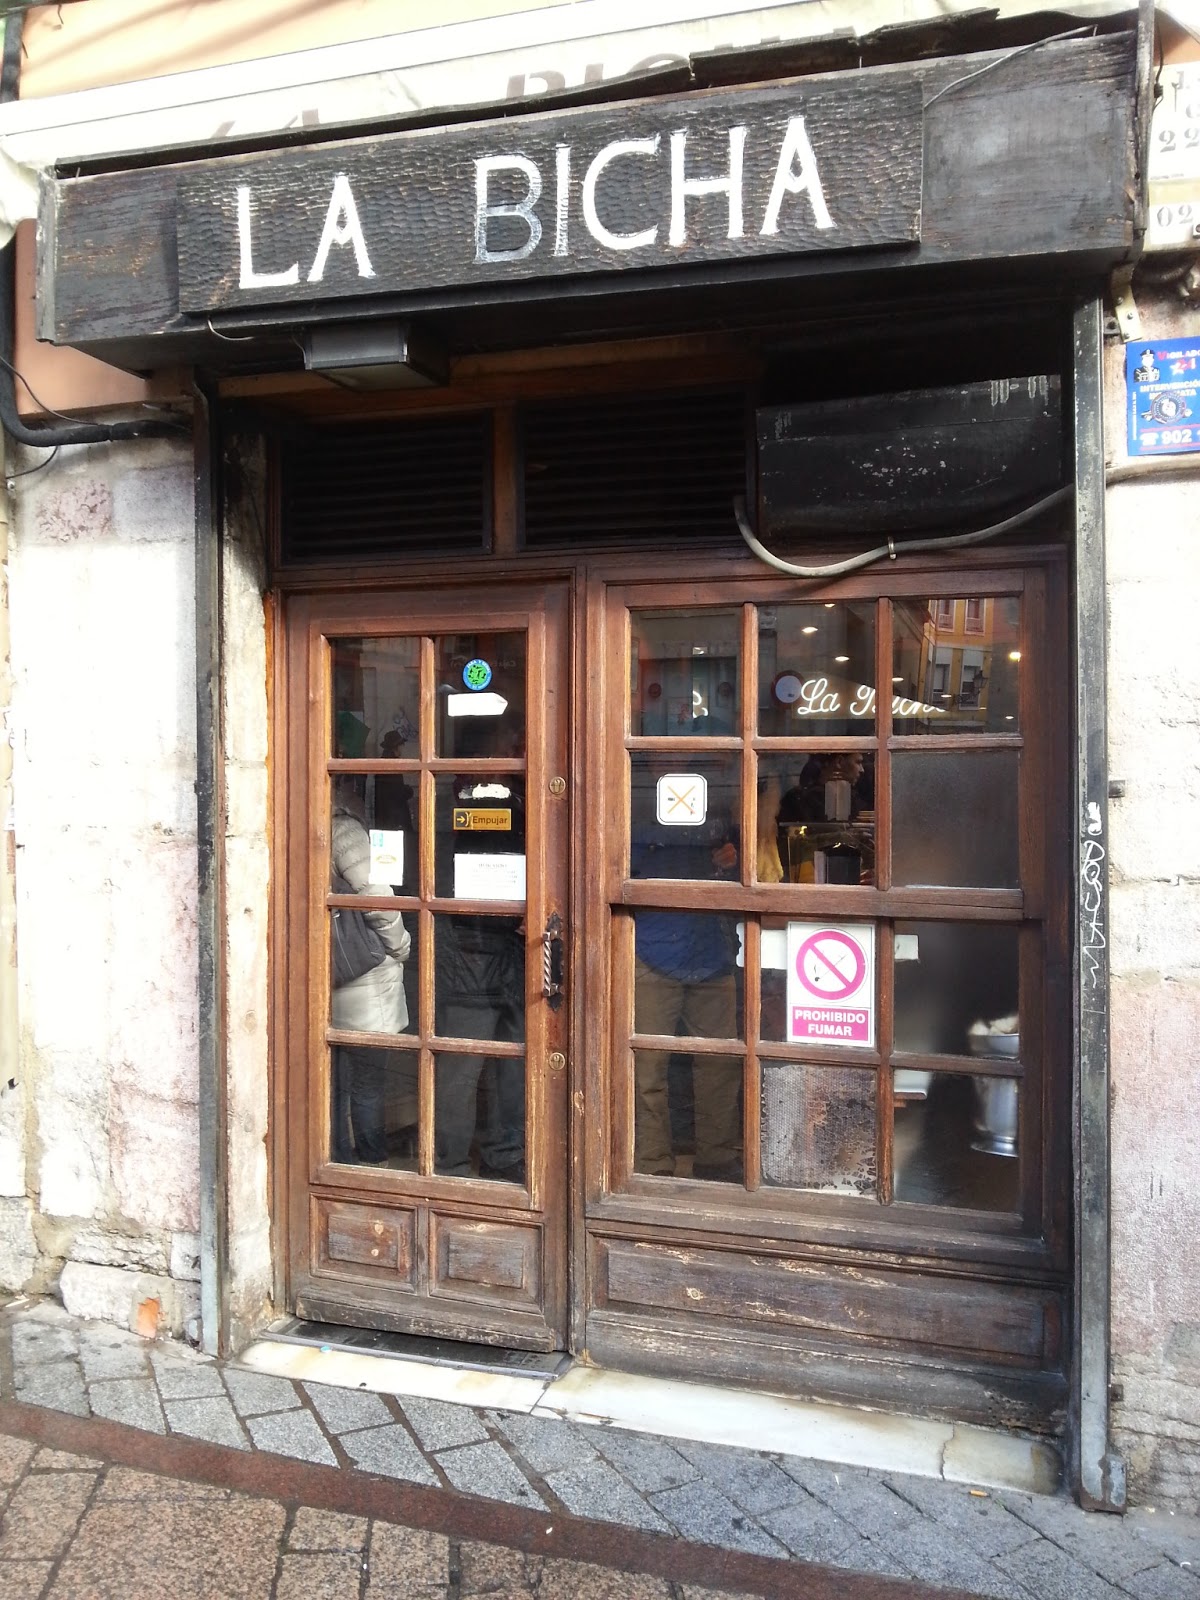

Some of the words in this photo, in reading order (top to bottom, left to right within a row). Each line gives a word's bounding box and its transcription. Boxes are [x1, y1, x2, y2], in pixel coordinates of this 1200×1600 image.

[236, 172, 377, 289] LA
[473, 115, 837, 266] BICHA
[1161, 429, 1192, 445] 902
[797, 678, 841, 715] La
[472, 815, 508, 825] Empujar
[794, 1009, 866, 1024] PROHIBIDO
[808, 1023, 853, 1036] FUMAR
